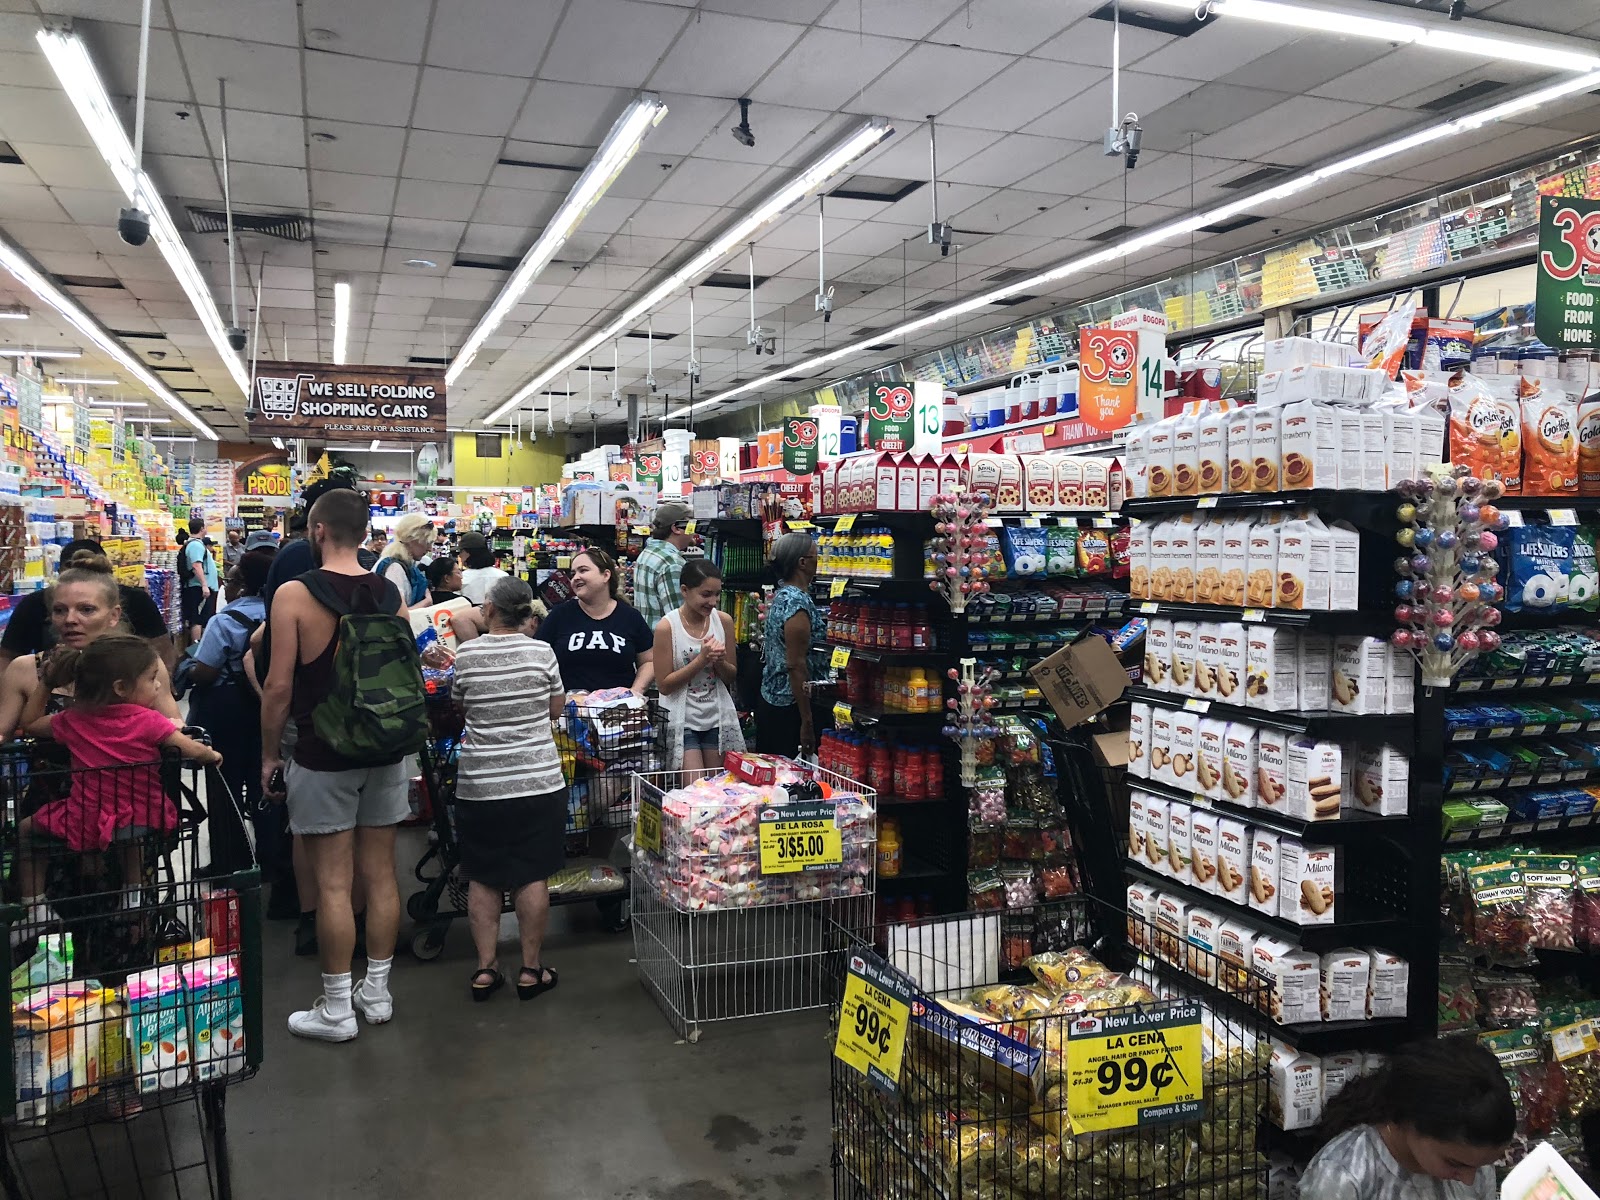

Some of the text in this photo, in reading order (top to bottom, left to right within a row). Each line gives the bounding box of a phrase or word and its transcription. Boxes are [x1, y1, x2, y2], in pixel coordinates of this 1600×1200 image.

[1566, 292, 1594, 307] FOOD
[1114, 315, 1138, 328] BOGOPA
[1142, 314, 1166, 327] BOGOPA
[1564, 310, 1594, 324] FROM
[1563, 329, 1592, 343] HOME
[1142, 357, 1162, 398] 14
[308, 382, 436, 400] WE SELL FOLDING
[1094, 395, 1120, 408] Thank
[301, 402, 428, 418] SHOPPING CARTS
[1100, 407, 1114, 420] you
[918, 404, 940, 434] 13
[356, 424, 372, 432] ASK
[1062, 424, 1084, 440] THANK
[822, 432, 838, 456] 12
[724, 452, 738, 472] 11
[665, 466, 680, 482] 10
[1520, 544, 1538, 556] LIFE
[568, 630, 626, 654] GAP
[1226, 748, 1248, 760] Milano
[1260, 753, 1282, 766] Milano
[780, 810, 796, 818] New
[788, 822, 800, 830] LA
[778, 835, 824, 860] 3/$5.00
[1220, 840, 1240, 855] Milano
[1253, 850, 1274, 865] Milano
[1303, 864, 1332, 874] Milano
[1478, 888, 1522, 900] GUMMY WORMS
[866, 964, 910, 998] New Lower Price
[865, 984, 872, 998] LA
[874, 990, 891, 1009] CENA
[1105, 1007, 1196, 1028] New Lower Price
[1106, 1032, 1166, 1050] LA CENA
[1088, 1056, 1110, 1064] ANGEL
[1111, 1052, 1126, 1060] HAIR
[1139, 1048, 1160, 1056] FANCY
[1516, 1050, 1538, 1059] WORMS
[1098, 1054, 1174, 1096] 99¢
[1098, 1102, 1122, 1110] MANAGER
[1144, 1107, 1173, 1118] Compare
[1182, 1102, 1198, 1112] Save
